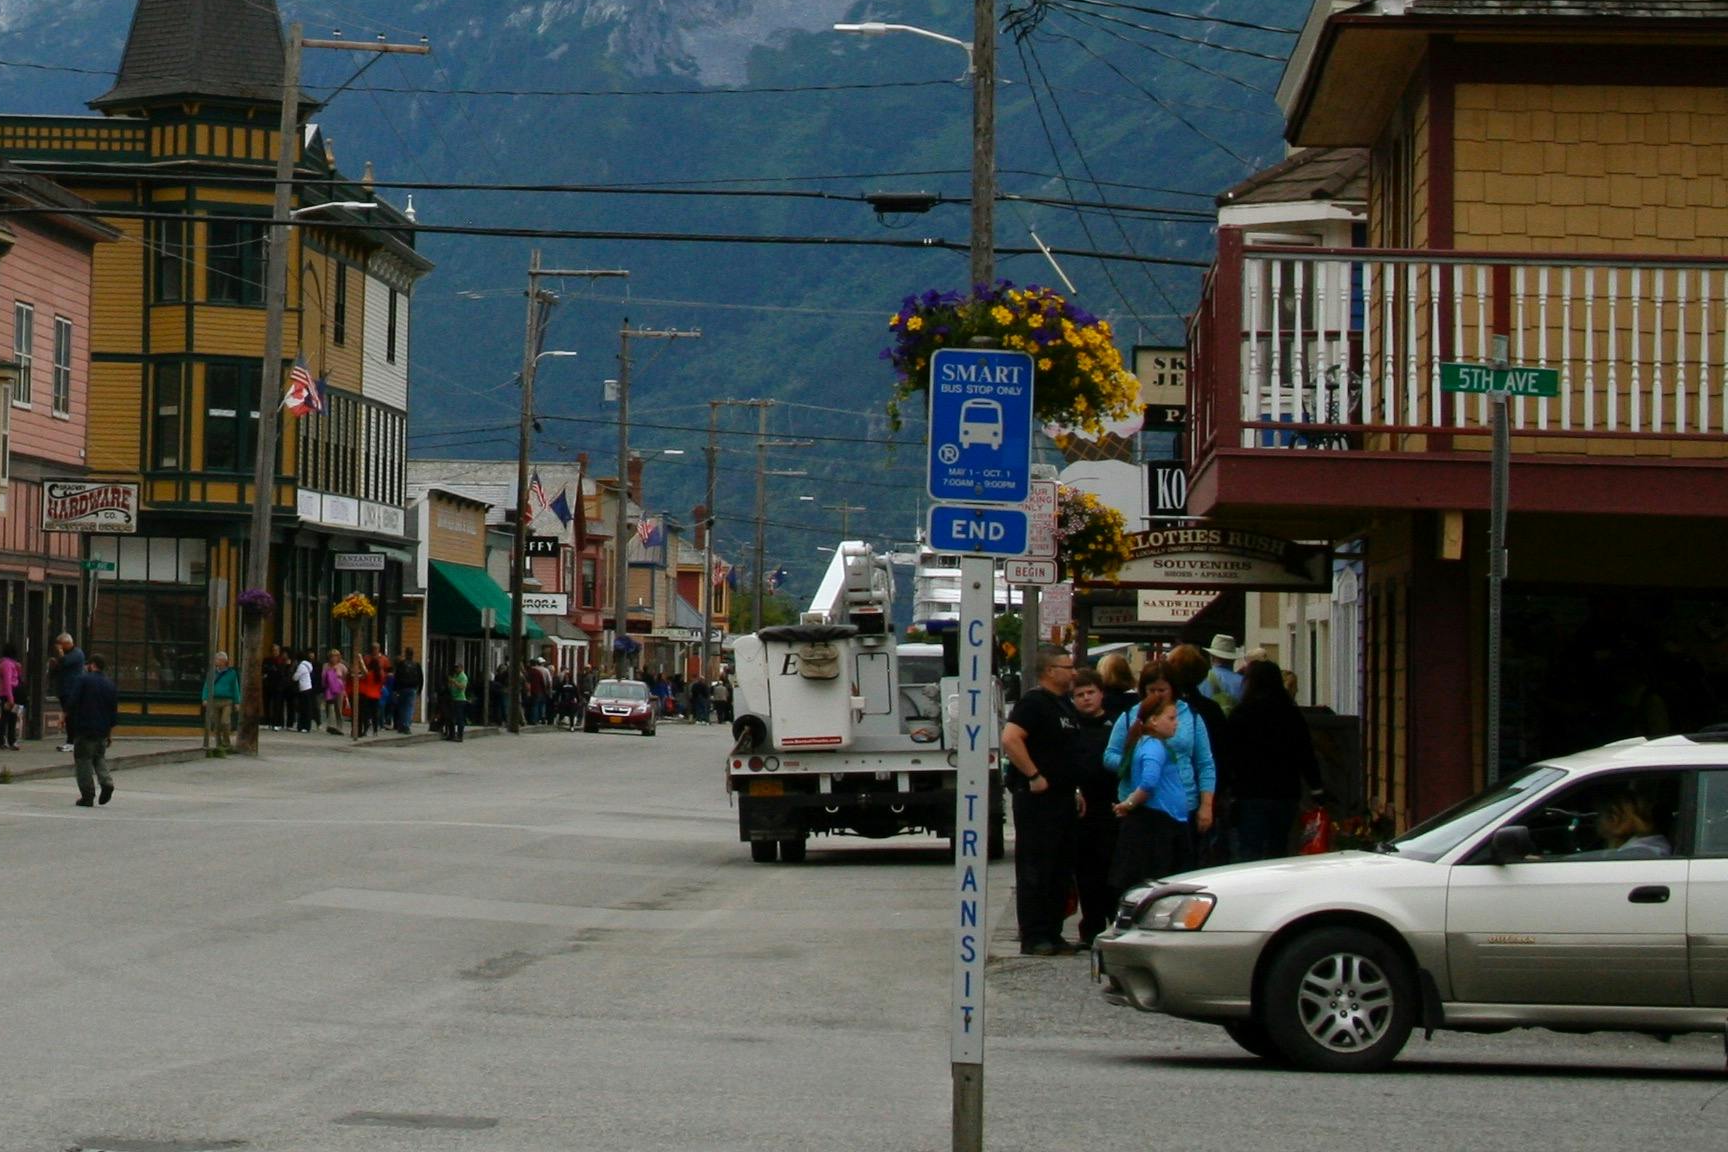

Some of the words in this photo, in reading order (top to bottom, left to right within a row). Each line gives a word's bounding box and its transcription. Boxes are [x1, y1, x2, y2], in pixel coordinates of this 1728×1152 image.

[942, 363, 1023, 384] SMART
[1459, 368, 1493, 389] 5TH
[1504, 371, 1539, 392] AVE
[941, 384, 962, 393] BUS
[966, 385, 993, 395] STOP
[997, 386, 1022, 396] ONLY
[949, 468, 965, 476] MAY
[984, 479, 1016, 489] 9:00PM
[48, 487, 132, 520] HARDWARE
[952, 520, 1005, 541] END
[1130, 529, 1221, 550] LOTHES
[1228, 532, 1286, 555] RUSH
[1015, 566, 1046, 577] BEGIN
[1153, 560, 1252, 571] SOUVENIRS
[1144, 600, 1210, 608] SANDWICH
[965, 620, 984, 752] CITY
[960, 794, 979, 1033] TRANSIT
